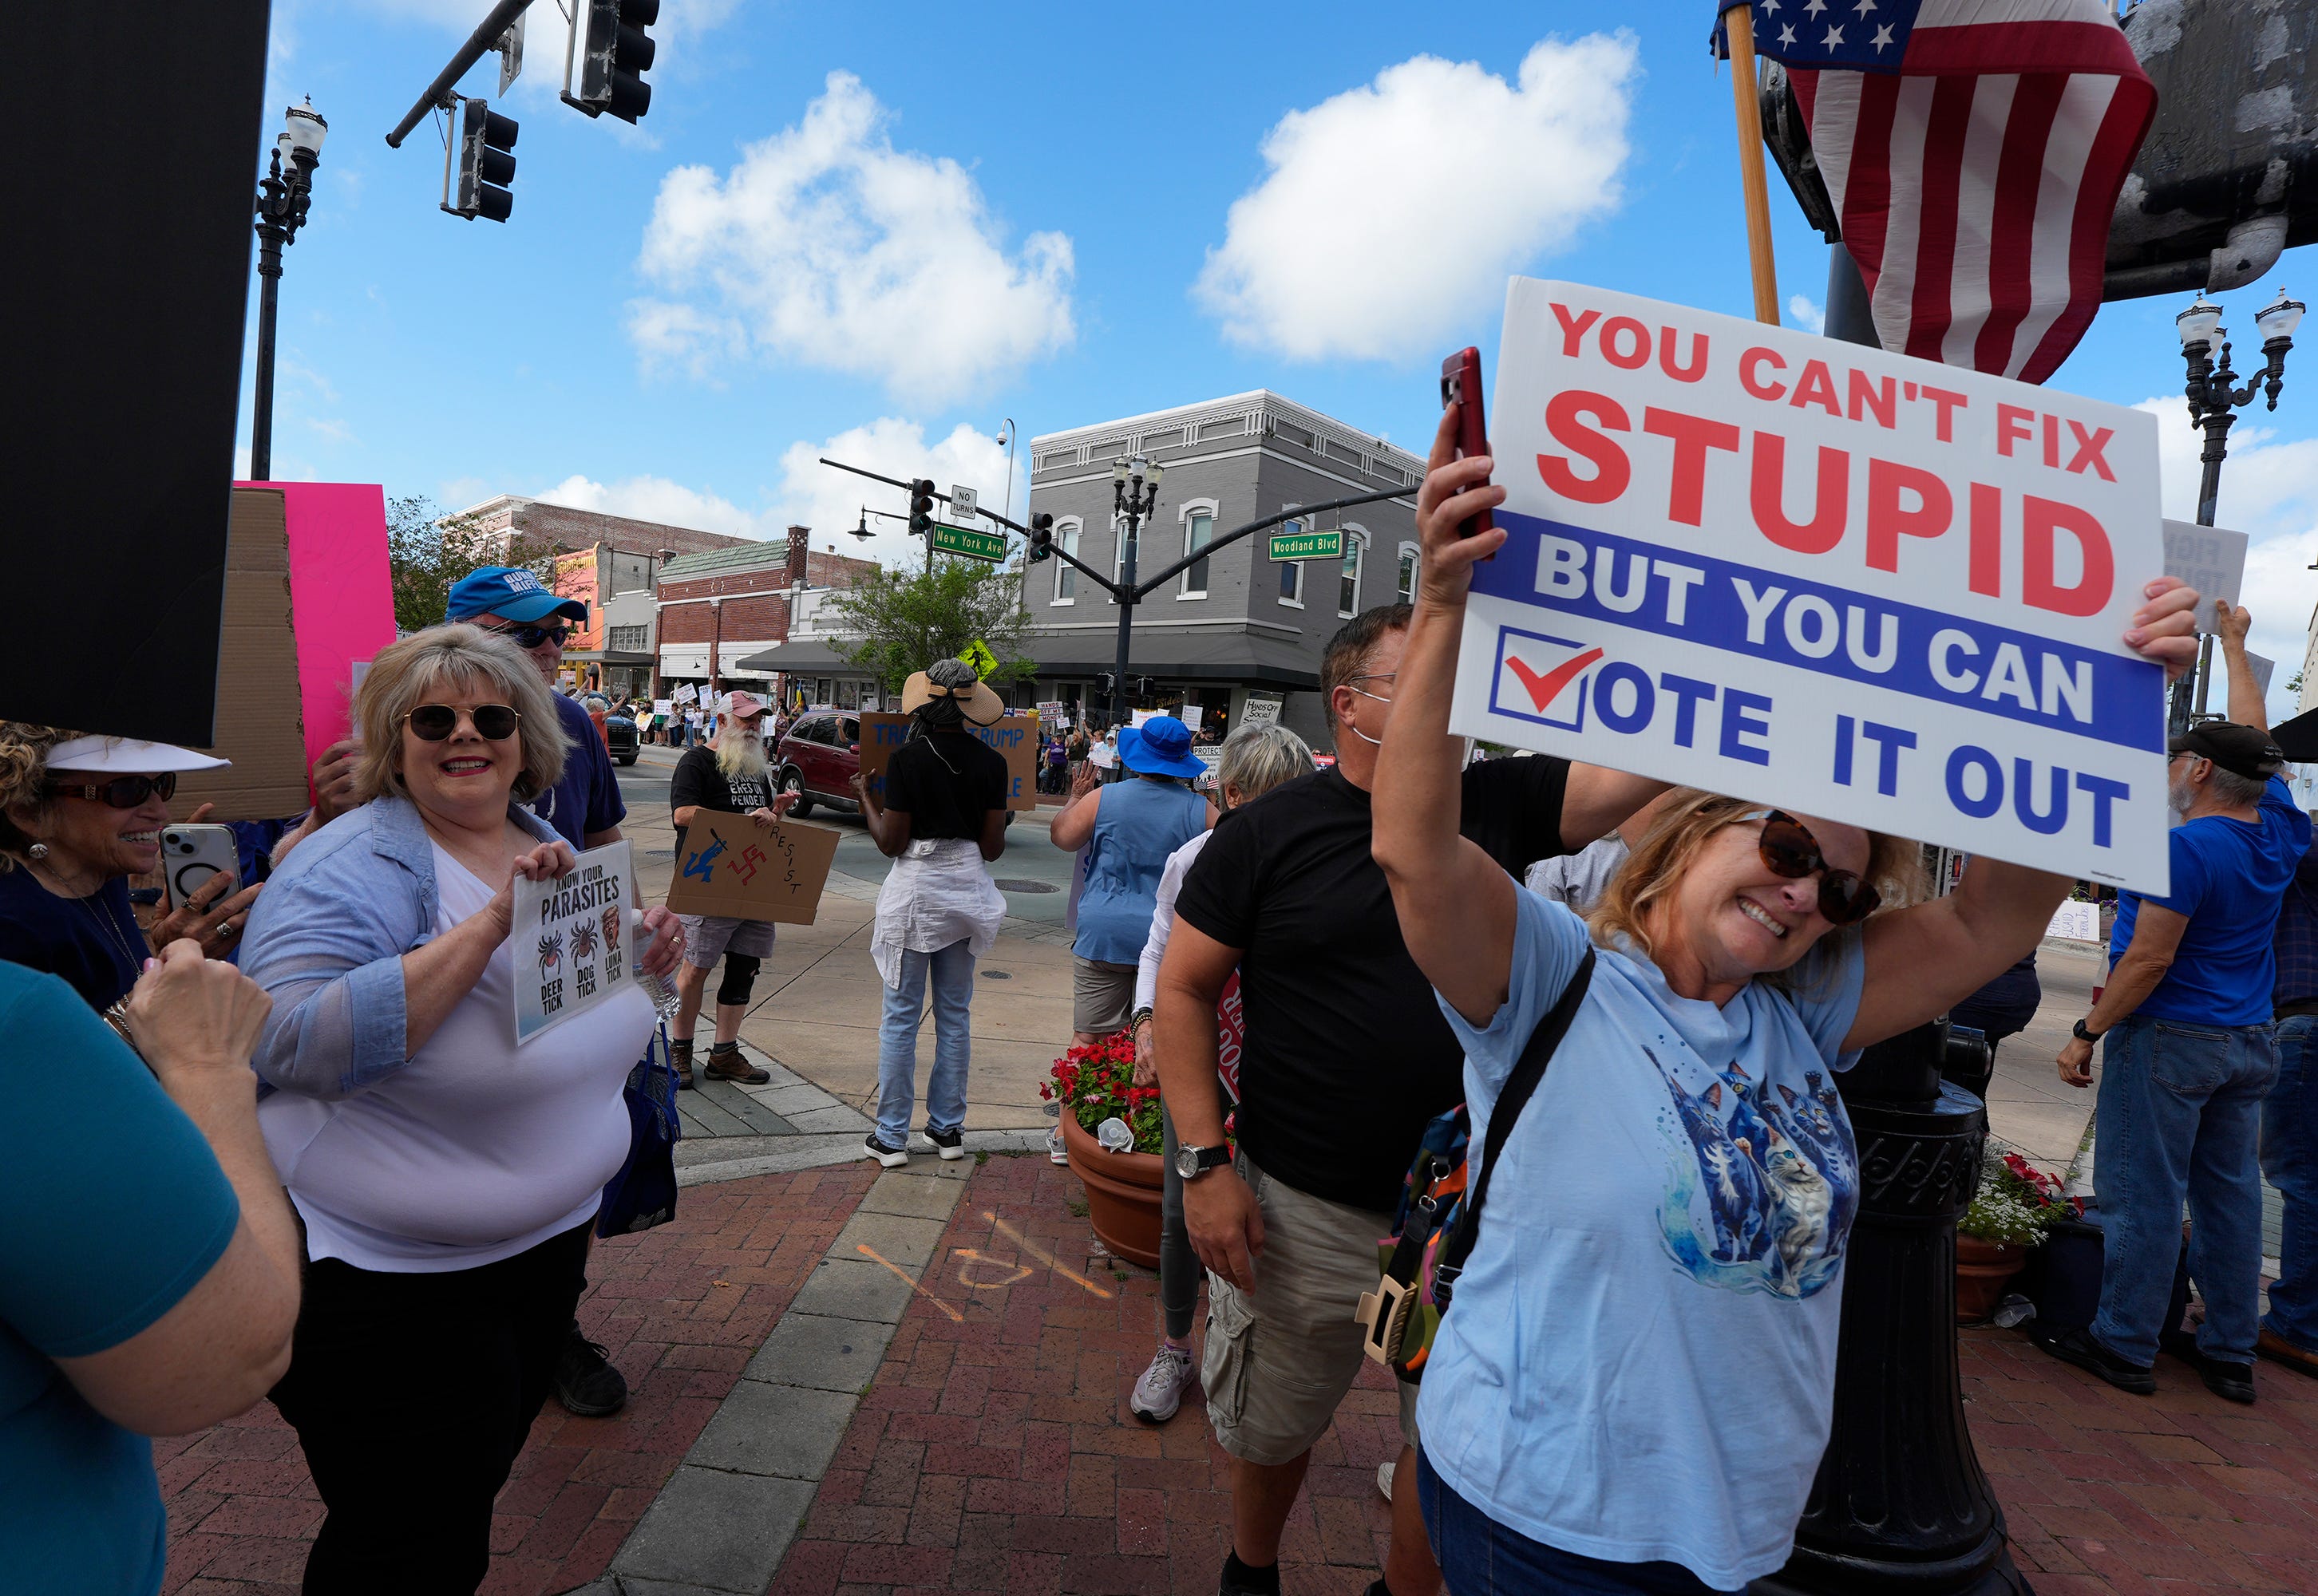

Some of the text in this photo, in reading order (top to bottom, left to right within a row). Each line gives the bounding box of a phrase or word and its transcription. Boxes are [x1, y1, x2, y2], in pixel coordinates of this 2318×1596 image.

[1550, 303, 2115, 481] YOU CAN'T FIX
[959, 492, 970, 501] NO
[1537, 390, 2114, 616] STUPID
[953, 503, 973, 514] TURNS
[937, 530, 1002, 554] New York Ave
[1274, 538, 1336, 552] Woodland Blvd
[1535, 536, 2091, 723] BUT YOU CAN
[1247, 701, 1267, 711] HANDS
[1833, 715, 1917, 796] IT
[1946, 745, 2129, 847] OUT
[731, 794, 766, 806] PENDEJO
[769, 826, 801, 895] RESIST
[556, 864, 603, 892] KNOW YOUR
[541, 875, 619, 926] PARASITES
[605, 950, 622, 971] LUNA
[577, 965, 595, 985] DOG
[607, 966, 622, 985] TICK
[541, 979, 563, 1001] DEER
[576, 979, 596, 999] TICK
[543, 994, 563, 1016] TICK
